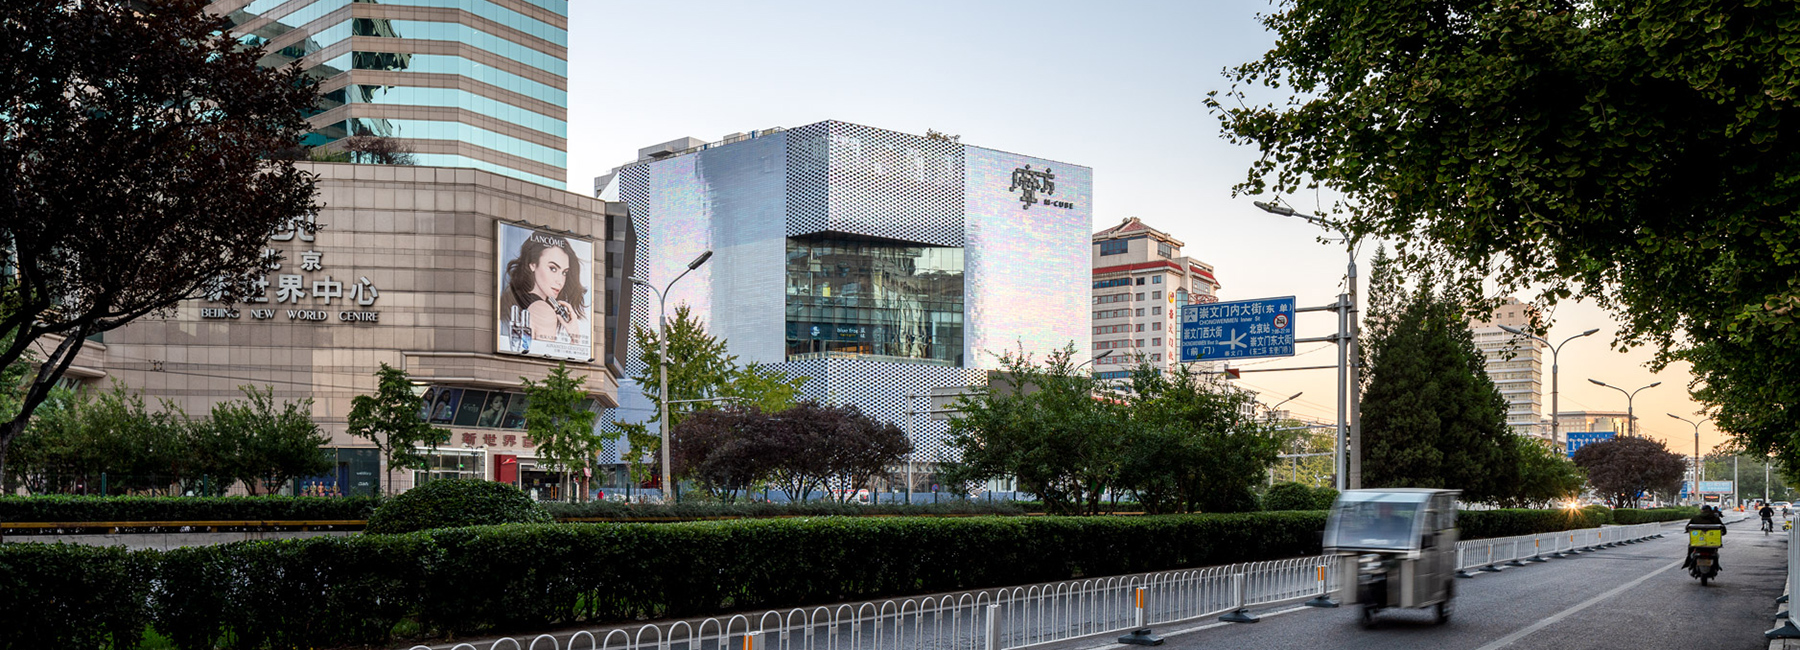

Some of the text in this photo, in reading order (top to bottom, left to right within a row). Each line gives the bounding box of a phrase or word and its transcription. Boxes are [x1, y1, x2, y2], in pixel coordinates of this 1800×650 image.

[1043, 198, 1074, 209] M-CUBE
[530, 234, 565, 248] LANCÔME
[201, 308, 379, 322] BEIJING NEW WORLD CENTRE
[1199, 302, 1262, 319] 崇文门内大街
[1199, 317, 1239, 325] CHONGWENMEN
[1183, 326, 1222, 340] 崇文门西大街
[1249, 322, 1270, 335] 北京站
[1250, 334, 1292, 347] 崇文门东大街
[461, 432, 554, 448] 新世界百
